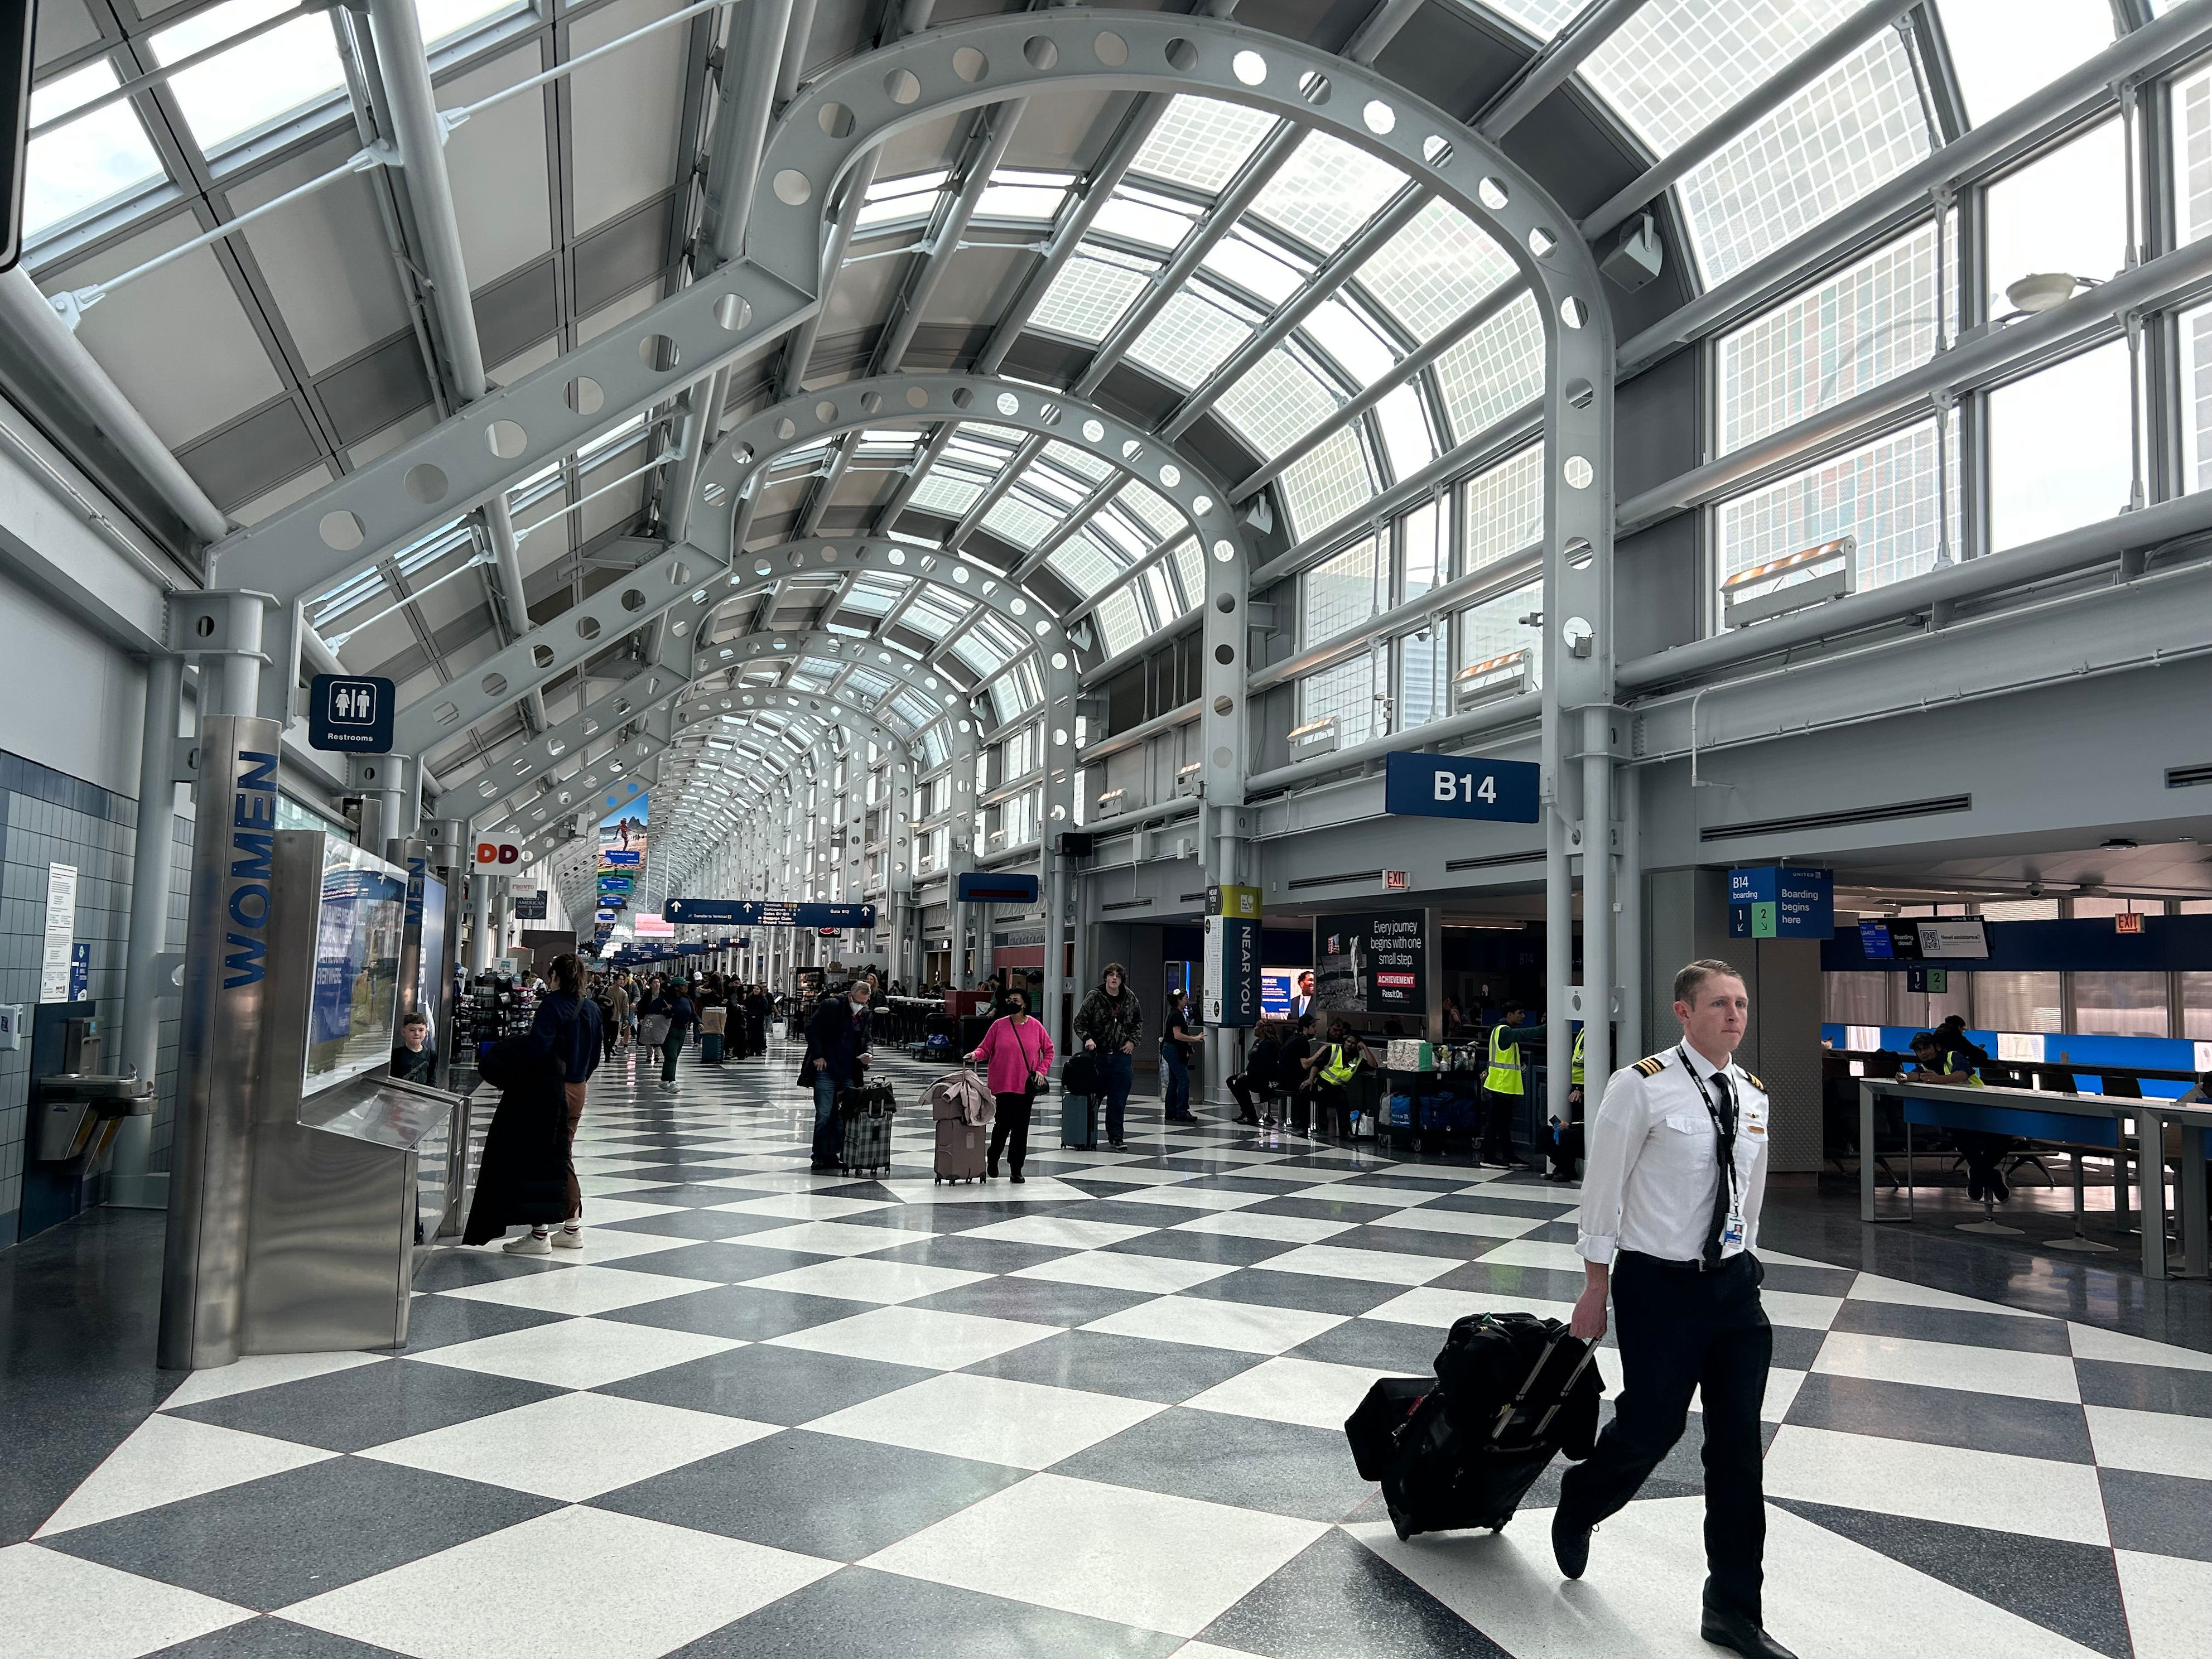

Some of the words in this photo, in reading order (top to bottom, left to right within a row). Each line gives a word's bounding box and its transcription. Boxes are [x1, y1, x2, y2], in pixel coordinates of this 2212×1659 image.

[327, 733, 373, 742] Restrooms
[1434, 771, 1496, 804] B14
[478, 843, 518, 864] DD
[224, 751, 278, 989] WOMEN
[1387, 871, 1406, 885] EXIT
[1733, 876, 1749, 889] B14
[405, 857, 426, 924] MEN
[1733, 891, 1758, 899] boarding
[1781, 889, 1819, 900] Boarding
[1738, 910, 1742, 920] 1
[1761, 909, 1766, 918] 2
[1782, 902, 1810, 913] begins
[1782, 915, 1801, 924] here
[2119, 914, 2137, 928] EXIT
[1374, 920, 1392, 935] Every
[1392, 920, 1418, 935] journey
[1241, 926, 1251, 973] NEAR
[1370, 936, 1392, 951] begins
[1392, 935, 1407, 948] with
[1408, 938, 1421, 948] one
[1379, 952, 1396, 964] small
[1396, 953, 1414, 967] step.
[1520, 952, 1534, 964] B14
[1378, 975, 1414, 985] ACHIEVEMENT
[1915, 972, 1919, 982] 1
[1934, 973, 1940, 982] 2
[1241, 977, 1250, 1014] YOU
